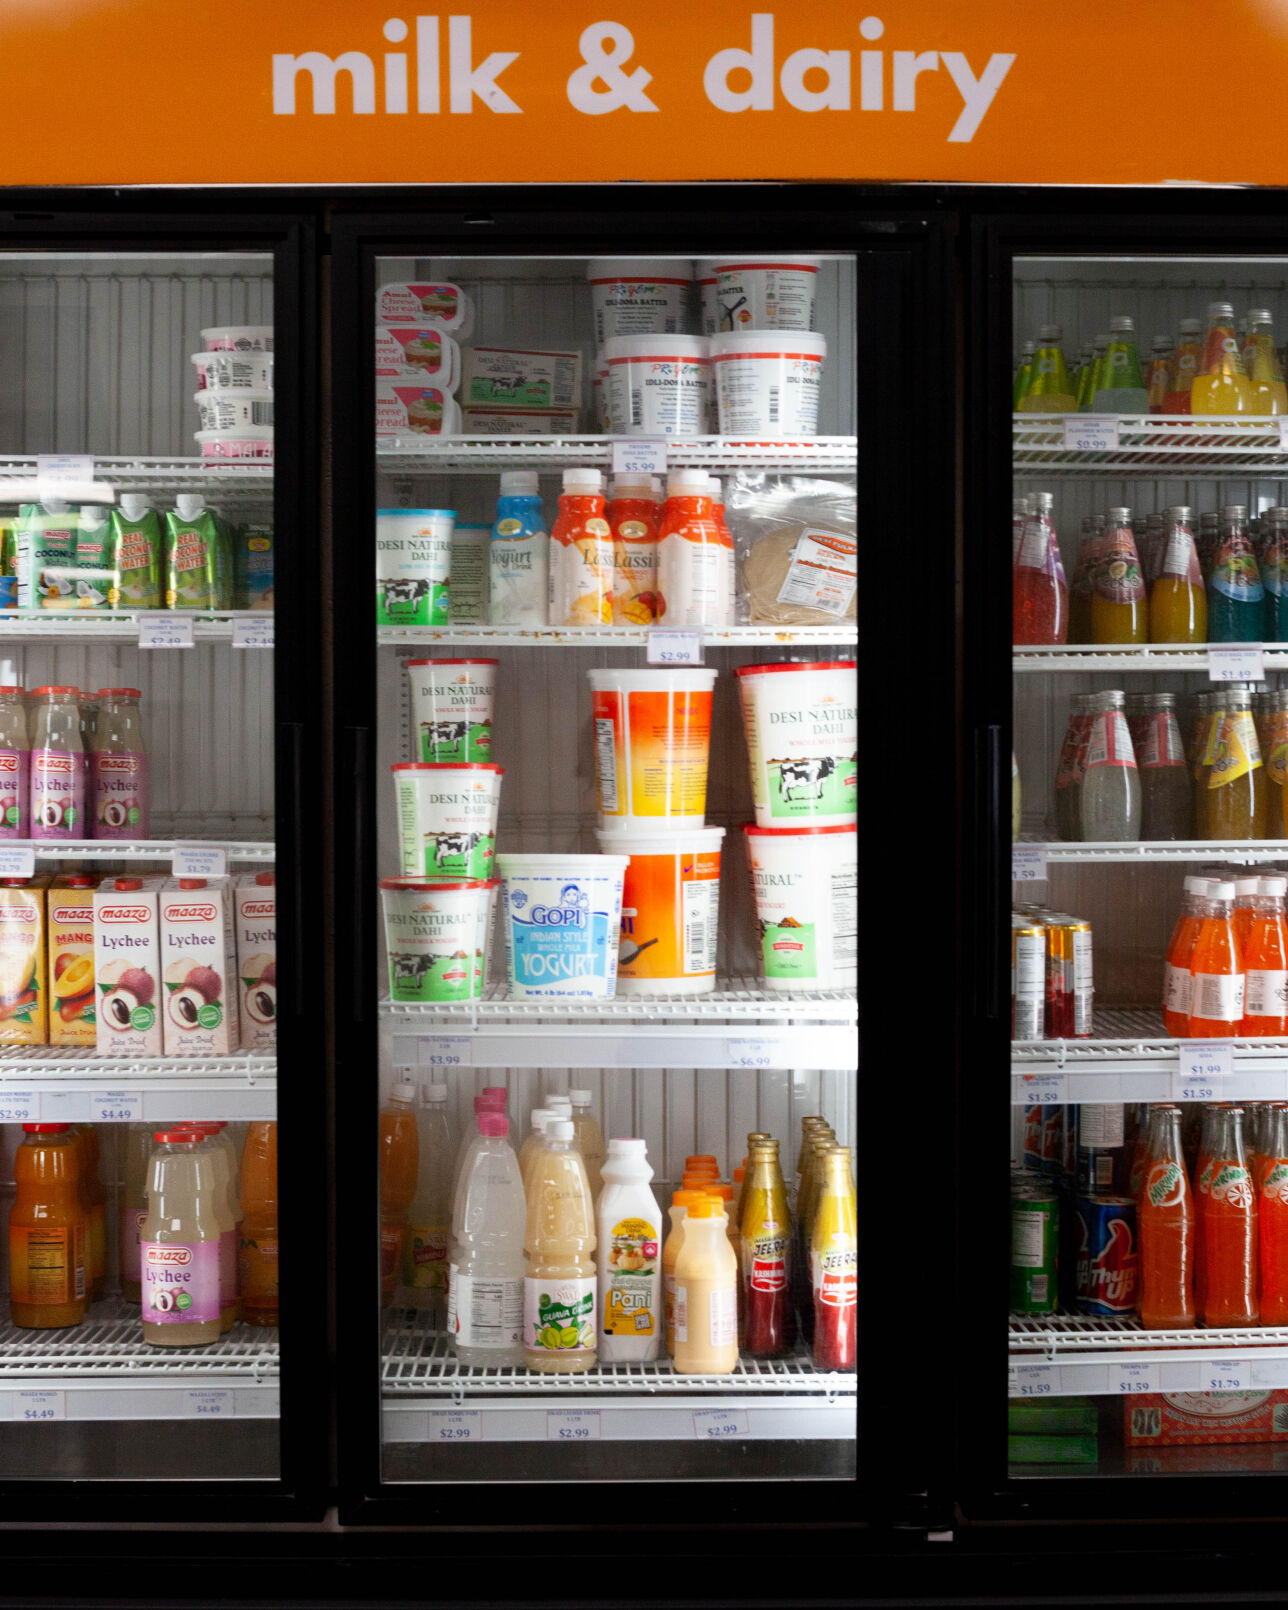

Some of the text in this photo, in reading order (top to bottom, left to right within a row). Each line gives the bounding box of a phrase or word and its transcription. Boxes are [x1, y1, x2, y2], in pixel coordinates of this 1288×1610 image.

[273, 13, 1016, 143] milk & dairy
[1077, 440, 1106, 448] $0.99
[625, 462, 655, 471] $5.99
[123, 532, 144, 545] REAL
[177, 532, 199, 545] REAL
[378, 540, 404, 550] DESI
[35, 550, 75, 558] COCONUT
[121, 556, 151, 571] WATER
[176, 556, 206, 572] WATER
[151, 637, 182, 647] $2.49
[661, 651, 690, 660] $2.99
[421, 686, 445, 696] DESI
[770, 711, 803, 724] DESI
[813, 723, 844, 735] DAHI
[34, 778, 76, 793] Lychee
[97, 779, 138, 793] Lychee
[430, 794, 458, 804] DESI
[187, 866, 211, 874] $1.79
[102, 909, 147, 919] maaza
[168, 906, 213, 917] maaza
[531, 906, 580, 925] GOPI
[413, 927, 442, 936] DAHI
[530, 931, 589, 942] INDIAN STYLE
[102, 935, 149, 949] Lychee
[168, 934, 216, 948] Lychee
[521, 953, 599, 977] YOGURT
[430, 1055, 460, 1064] $3.99
[740, 1057, 770, 1065] $6.99
[1192, 1065, 1221, 1074] $1.99
[1028, 1093, 1058, 1102] $1.59
[1183, 1089, 1213, 1098] $1.59
[0, 1110, 29, 1119] $2.99
[101, 1110, 131, 1119] $4.49
[1212, 1167, 1248, 1187] MIRINDA
[1151, 1163, 1183, 1205] MIRINDA
[753, 1239, 785, 1257] JEERA
[148, 1252, 188, 1261] maaza
[146, 1268, 192, 1284] Lychee
[611, 1290, 652, 1308] Pani
[543, 1306, 570, 1322] GUAVA
[1020, 1384, 1050, 1394] $1.59
[1120, 1382, 1149, 1392] $1.59
[1210, 1379, 1240, 1389] $1.79
[25, 1409, 54, 1419] $4.49
[197, 1405, 220, 1413] $4.49
[440, 1429, 470, 1439] $2.99
[559, 1429, 589, 1438] $2.99
[707, 1425, 737, 1437] $2.99
